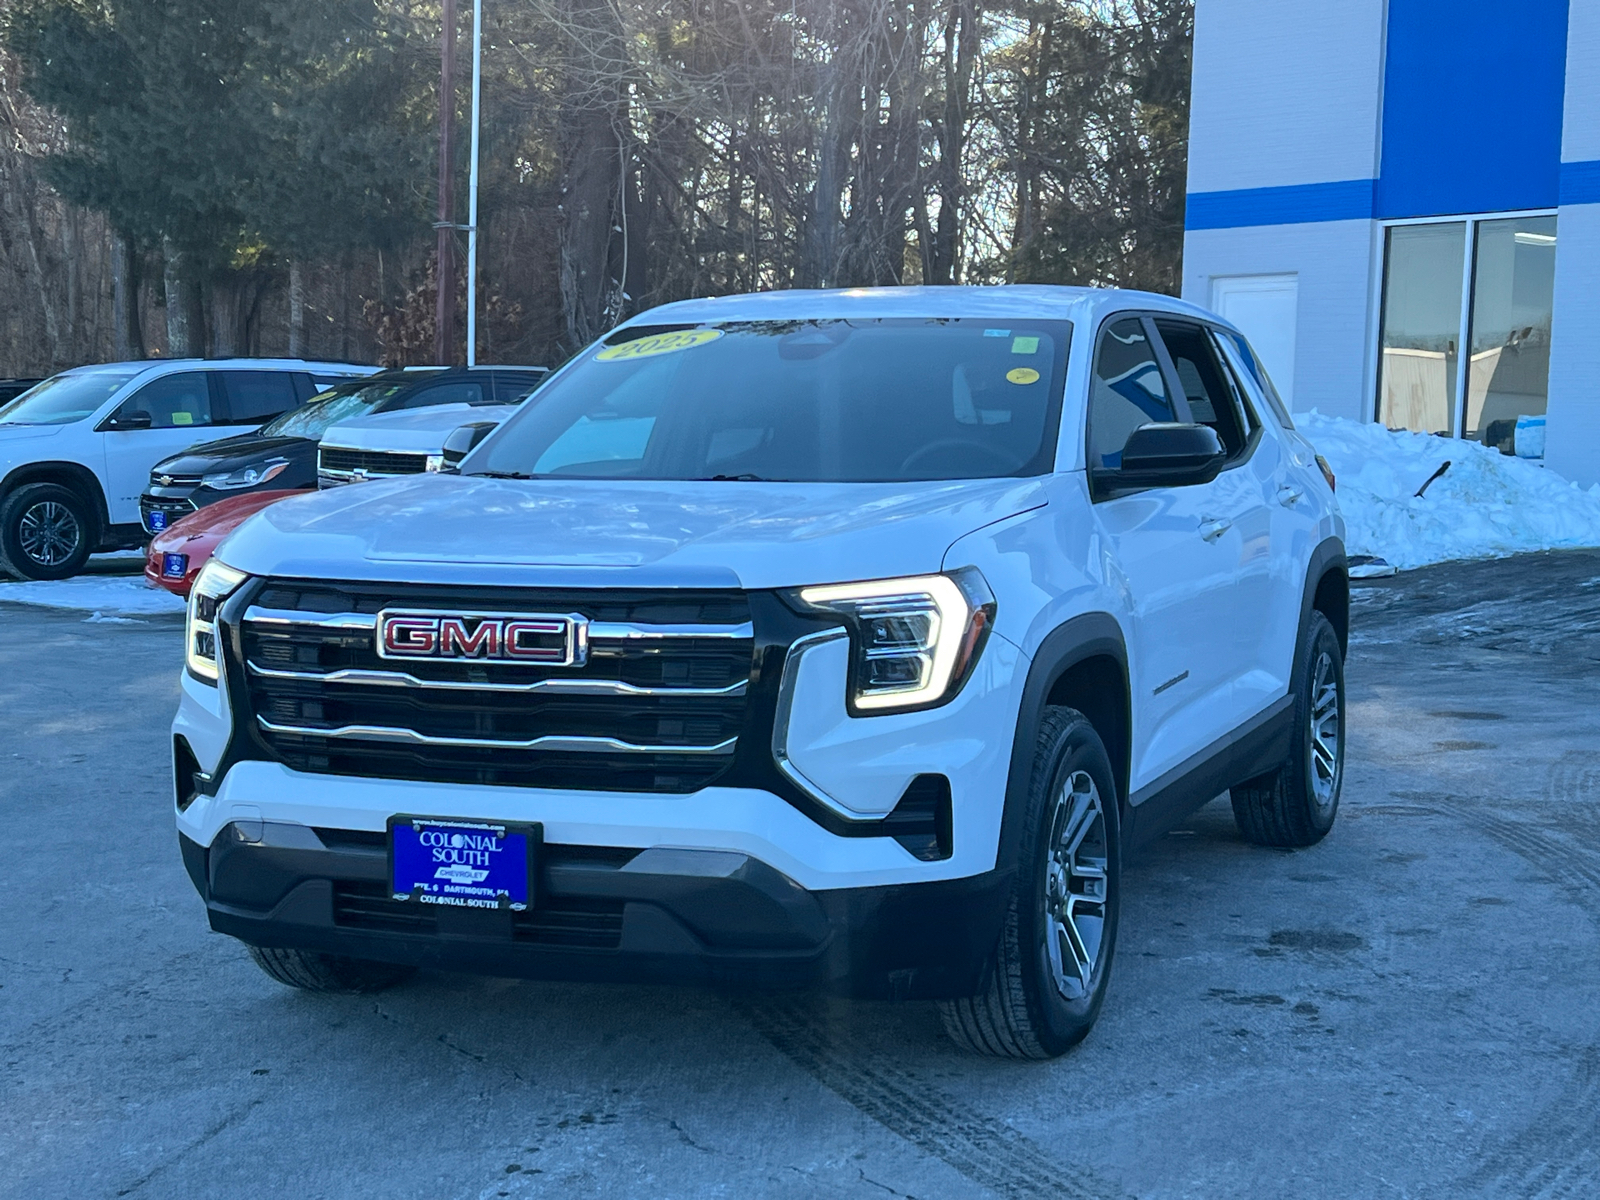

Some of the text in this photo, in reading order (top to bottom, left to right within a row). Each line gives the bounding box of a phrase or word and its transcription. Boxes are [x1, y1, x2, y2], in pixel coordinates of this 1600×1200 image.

[611, 332, 702, 359] 2025
[384, 617, 565, 660] GMC
[419, 831, 503, 852] COLONIAL
[432, 848, 490, 866] SOUTH
[440, 869, 483, 879] CHEVROLET
[433, 883, 439, 892] 6
[444, 884, 496, 898] DARTMOUTH,
[420, 894, 499, 909] COLONIAL SOUTH
